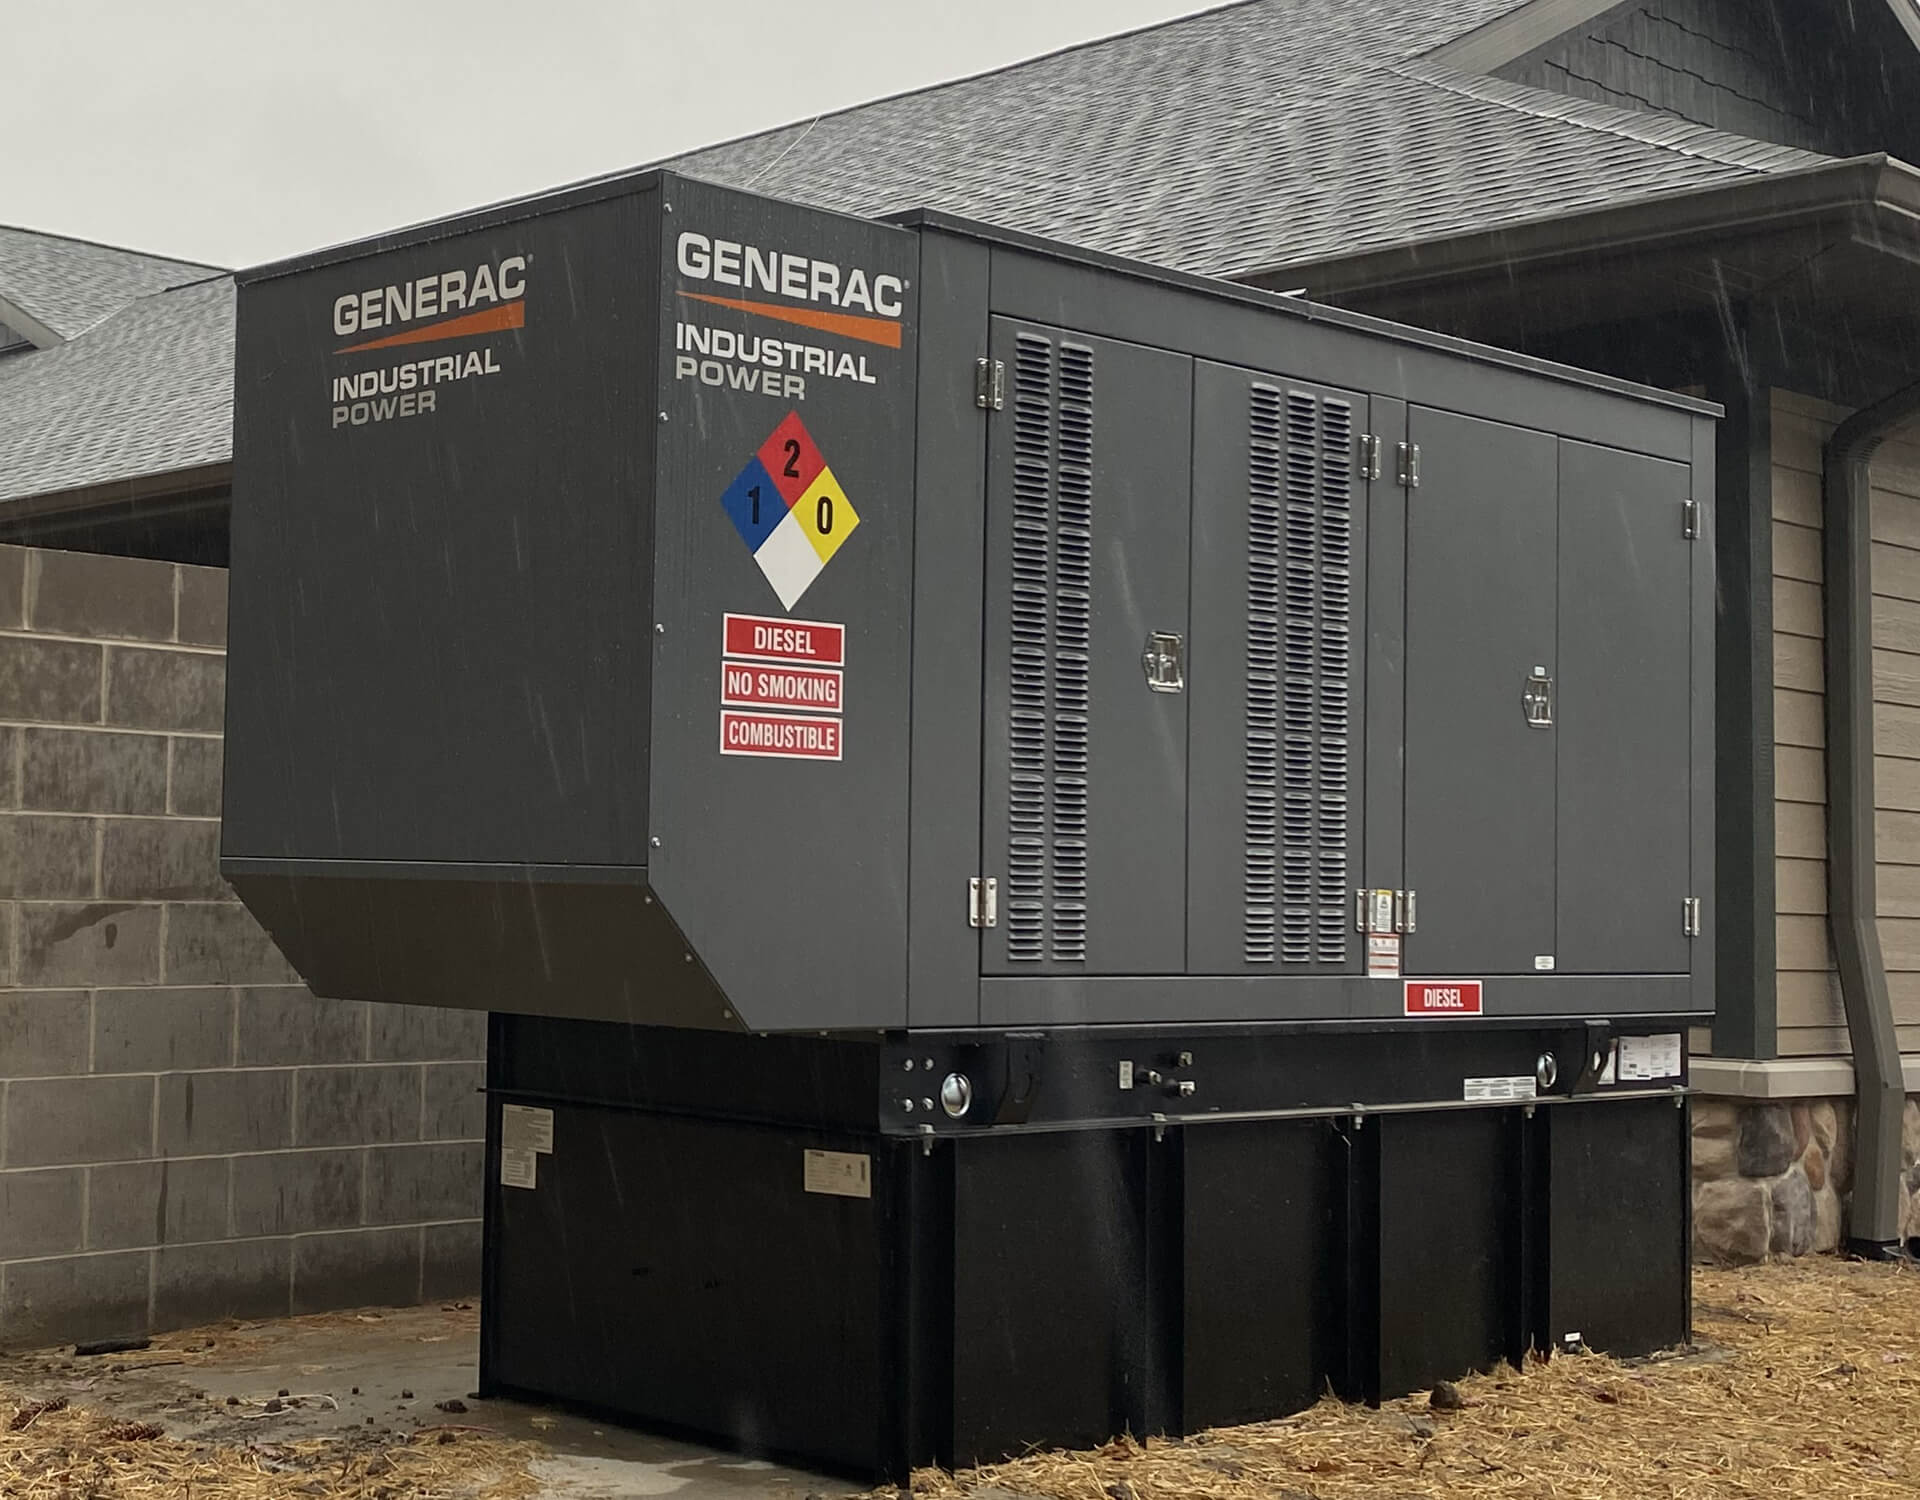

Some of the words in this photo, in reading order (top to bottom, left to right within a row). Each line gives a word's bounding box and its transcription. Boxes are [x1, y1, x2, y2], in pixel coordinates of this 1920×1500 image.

[676, 231, 903, 318] GENERAC
[333, 256, 526, 336] GENERAC
[675, 322, 877, 385] INDUSTRIAL
[332, 348, 501, 403] INDUSTRIAL
[675, 355, 806, 401] POWER
[332, 389, 437, 429] POWER
[783, 439, 801, 479] 2
[747, 485, 761, 525] 1
[816, 495, 834, 536] 0
[754, 626, 816, 655] DIESEL
[728, 671, 753, 696] NO
[757, 673, 837, 703] SMOKING
[728, 720, 836, 751] COMBUSTIBLE
[1423, 988, 1465, 1008] DIESEL
